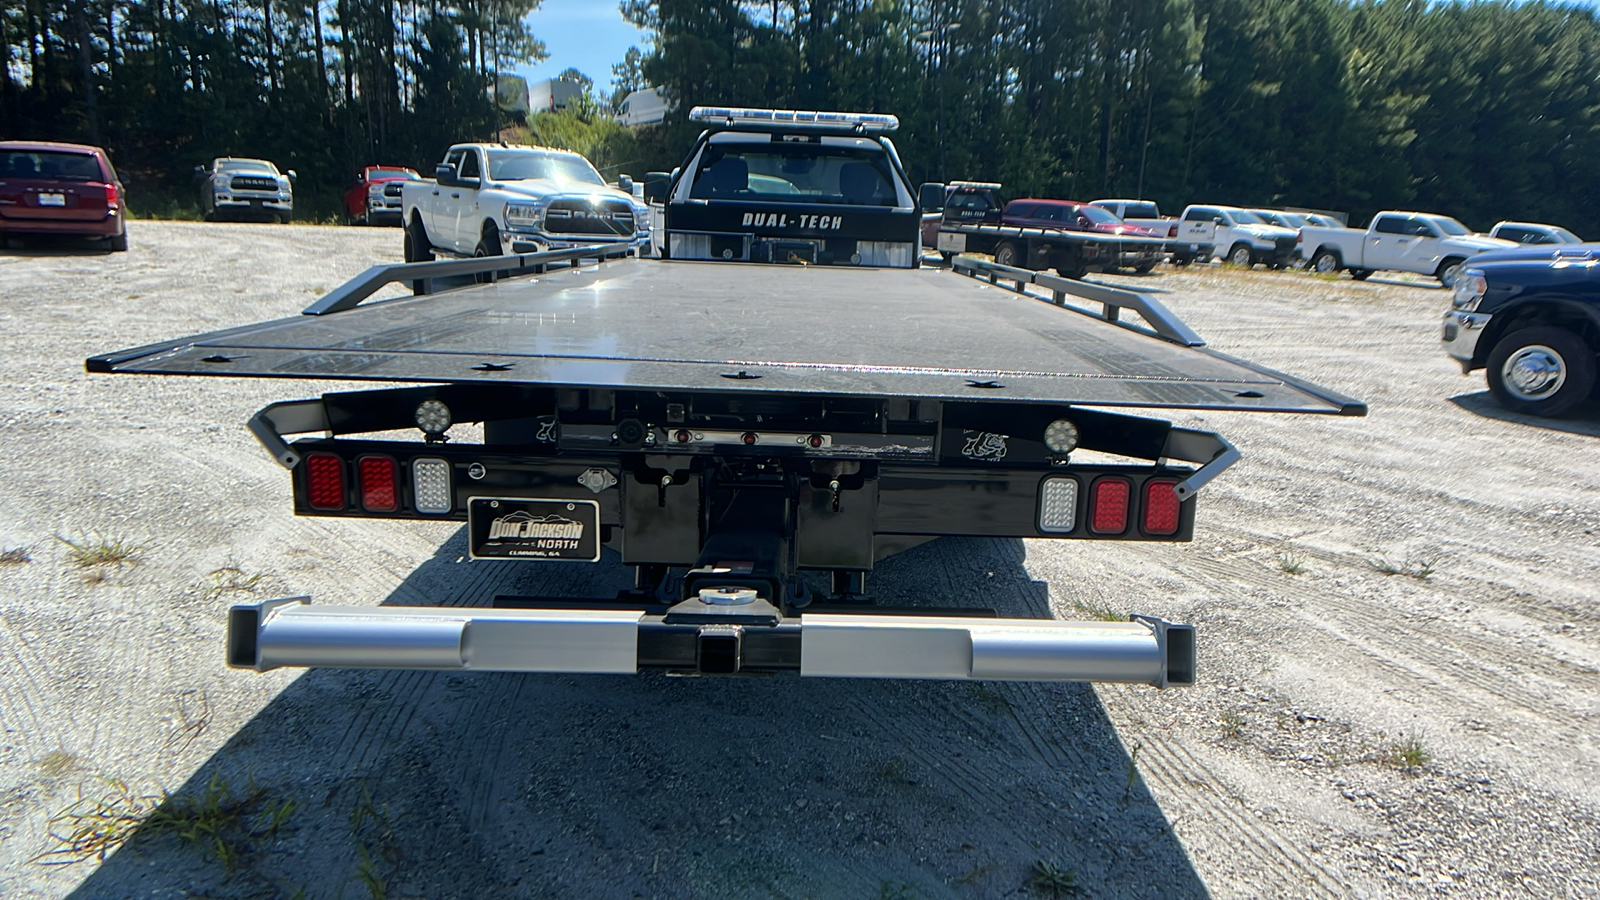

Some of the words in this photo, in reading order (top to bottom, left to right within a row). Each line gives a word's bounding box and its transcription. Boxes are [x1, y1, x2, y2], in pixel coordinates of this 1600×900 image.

[742, 212, 842, 230] DUAL-TECH
[520, 520, 584, 540] JACKSON
[537, 539, 579, 549] NORTH
